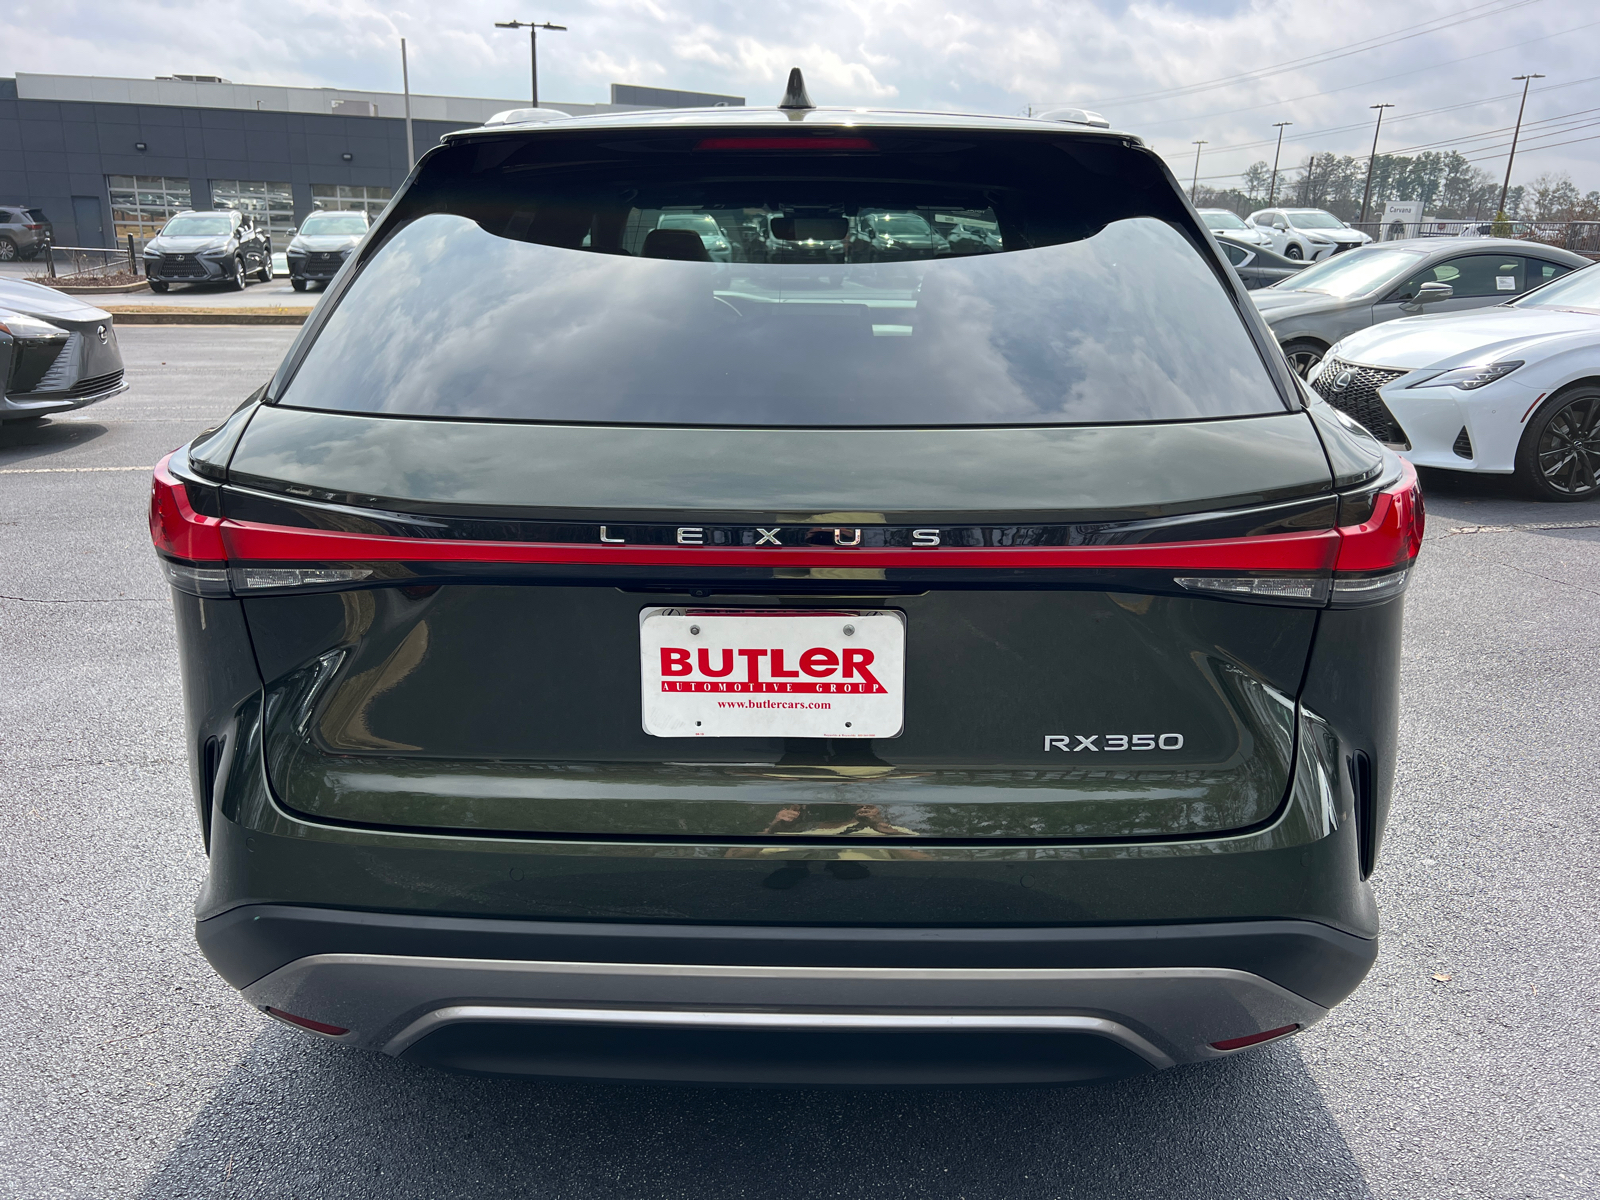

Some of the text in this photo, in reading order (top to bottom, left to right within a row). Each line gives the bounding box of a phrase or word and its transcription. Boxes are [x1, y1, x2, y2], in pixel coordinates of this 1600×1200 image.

[600, 526, 940, 546] LEXUS
[662, 682, 880, 693] AUTOMOTIVE GROUP
[717, 699, 832, 710] www.butlercars.com
